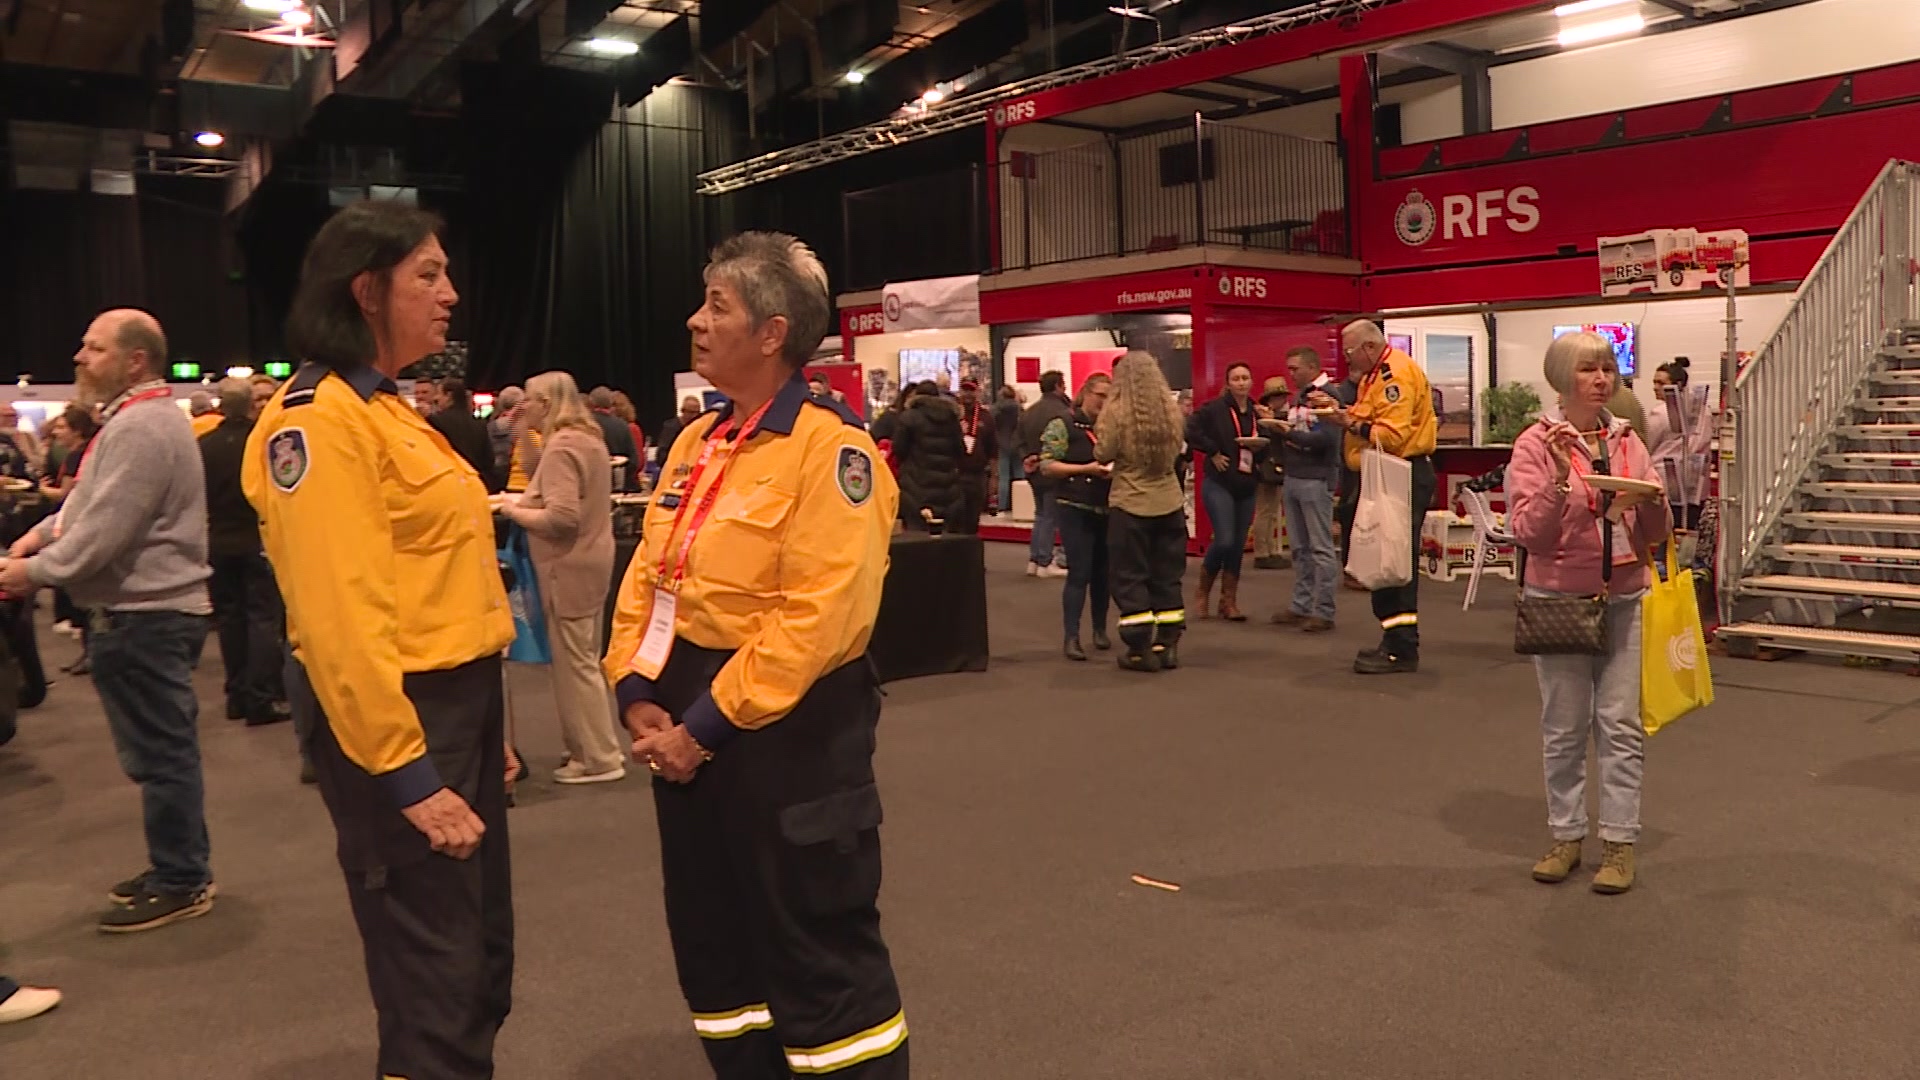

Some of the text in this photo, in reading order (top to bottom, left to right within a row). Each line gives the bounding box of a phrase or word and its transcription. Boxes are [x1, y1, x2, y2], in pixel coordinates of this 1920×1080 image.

[1007, 100, 1036, 121] RFS
[1443, 186, 1540, 240] RFS
[1616, 264, 1643, 278] RFS
[1117, 287, 1193, 305] rfs.nsw.gov.au
[1233, 276, 1267, 298] RFS
[859, 312, 883, 332] RFS
[1464, 547, 1498, 562] RS
